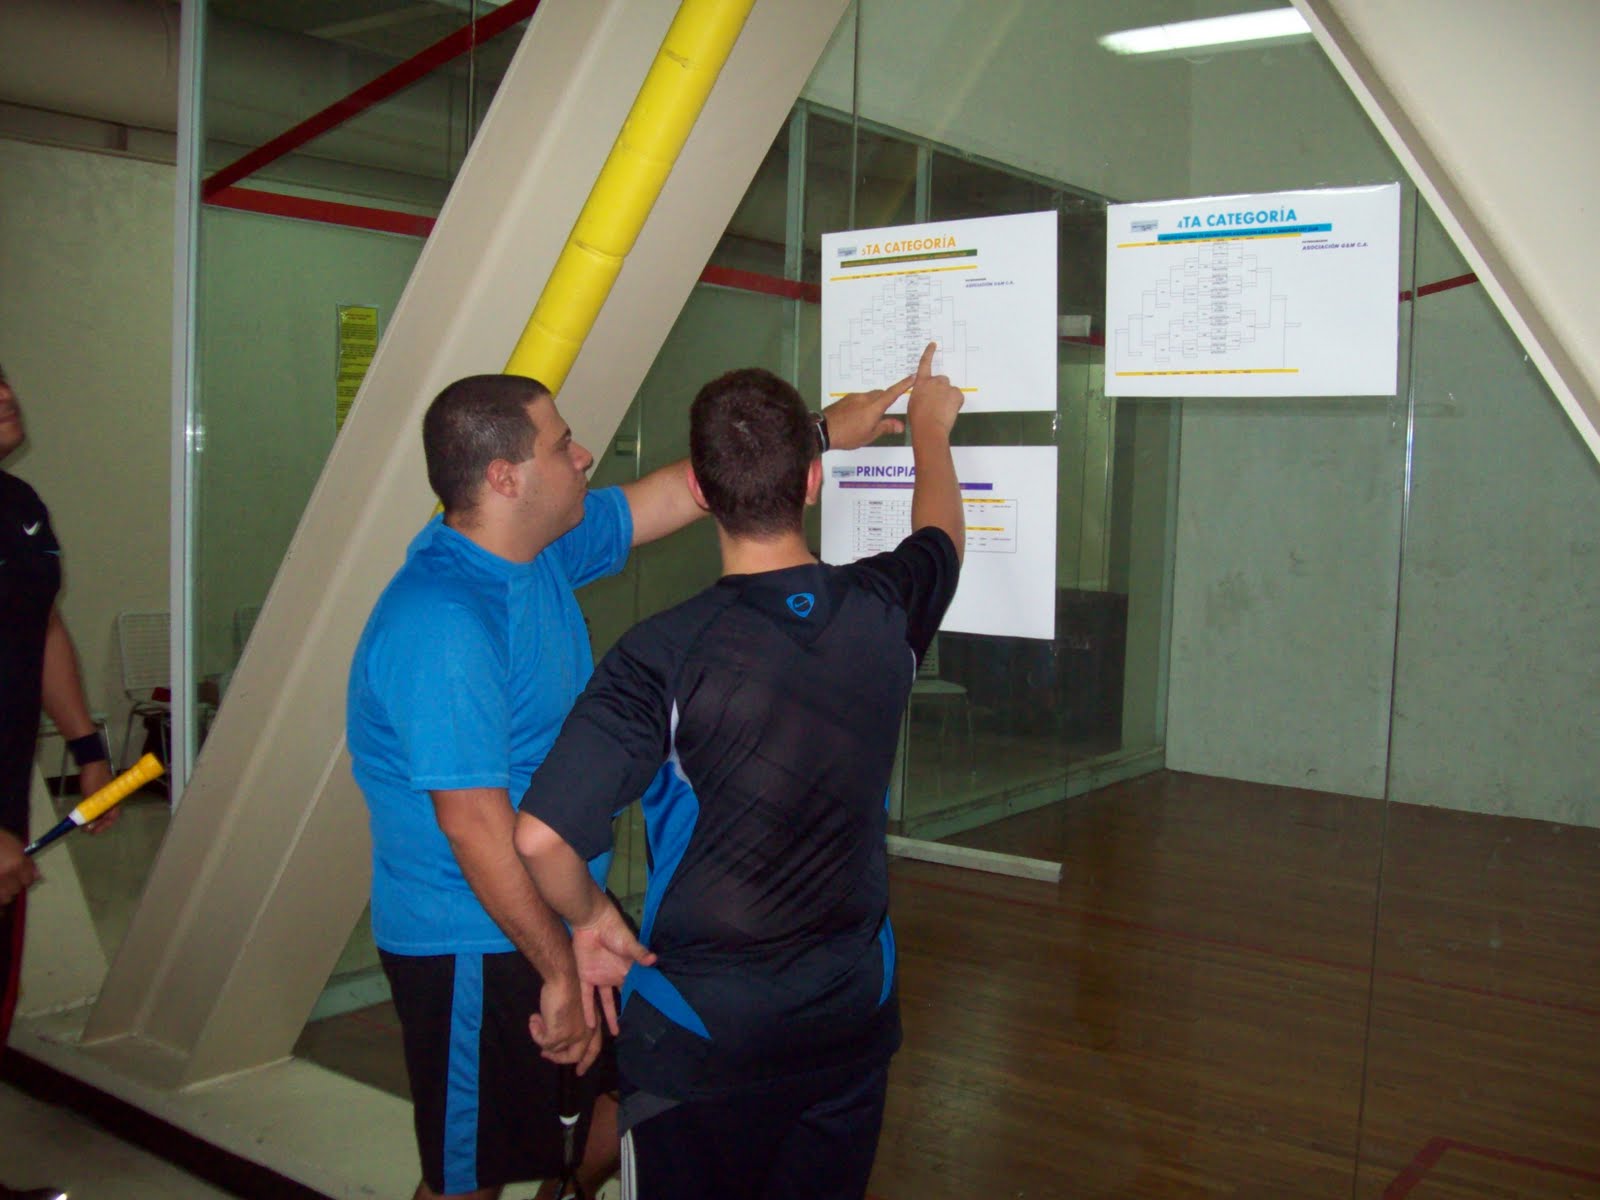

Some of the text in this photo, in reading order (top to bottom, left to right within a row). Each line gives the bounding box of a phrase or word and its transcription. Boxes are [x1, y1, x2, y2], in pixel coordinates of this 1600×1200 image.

[1177, 215, 1201, 229] 4TA
[1207, 205, 1297, 227] CATEGORÍA
[884, 234, 956, 254] CATEGORÍA
[856, 466, 915, 478] PRINCIPIA
